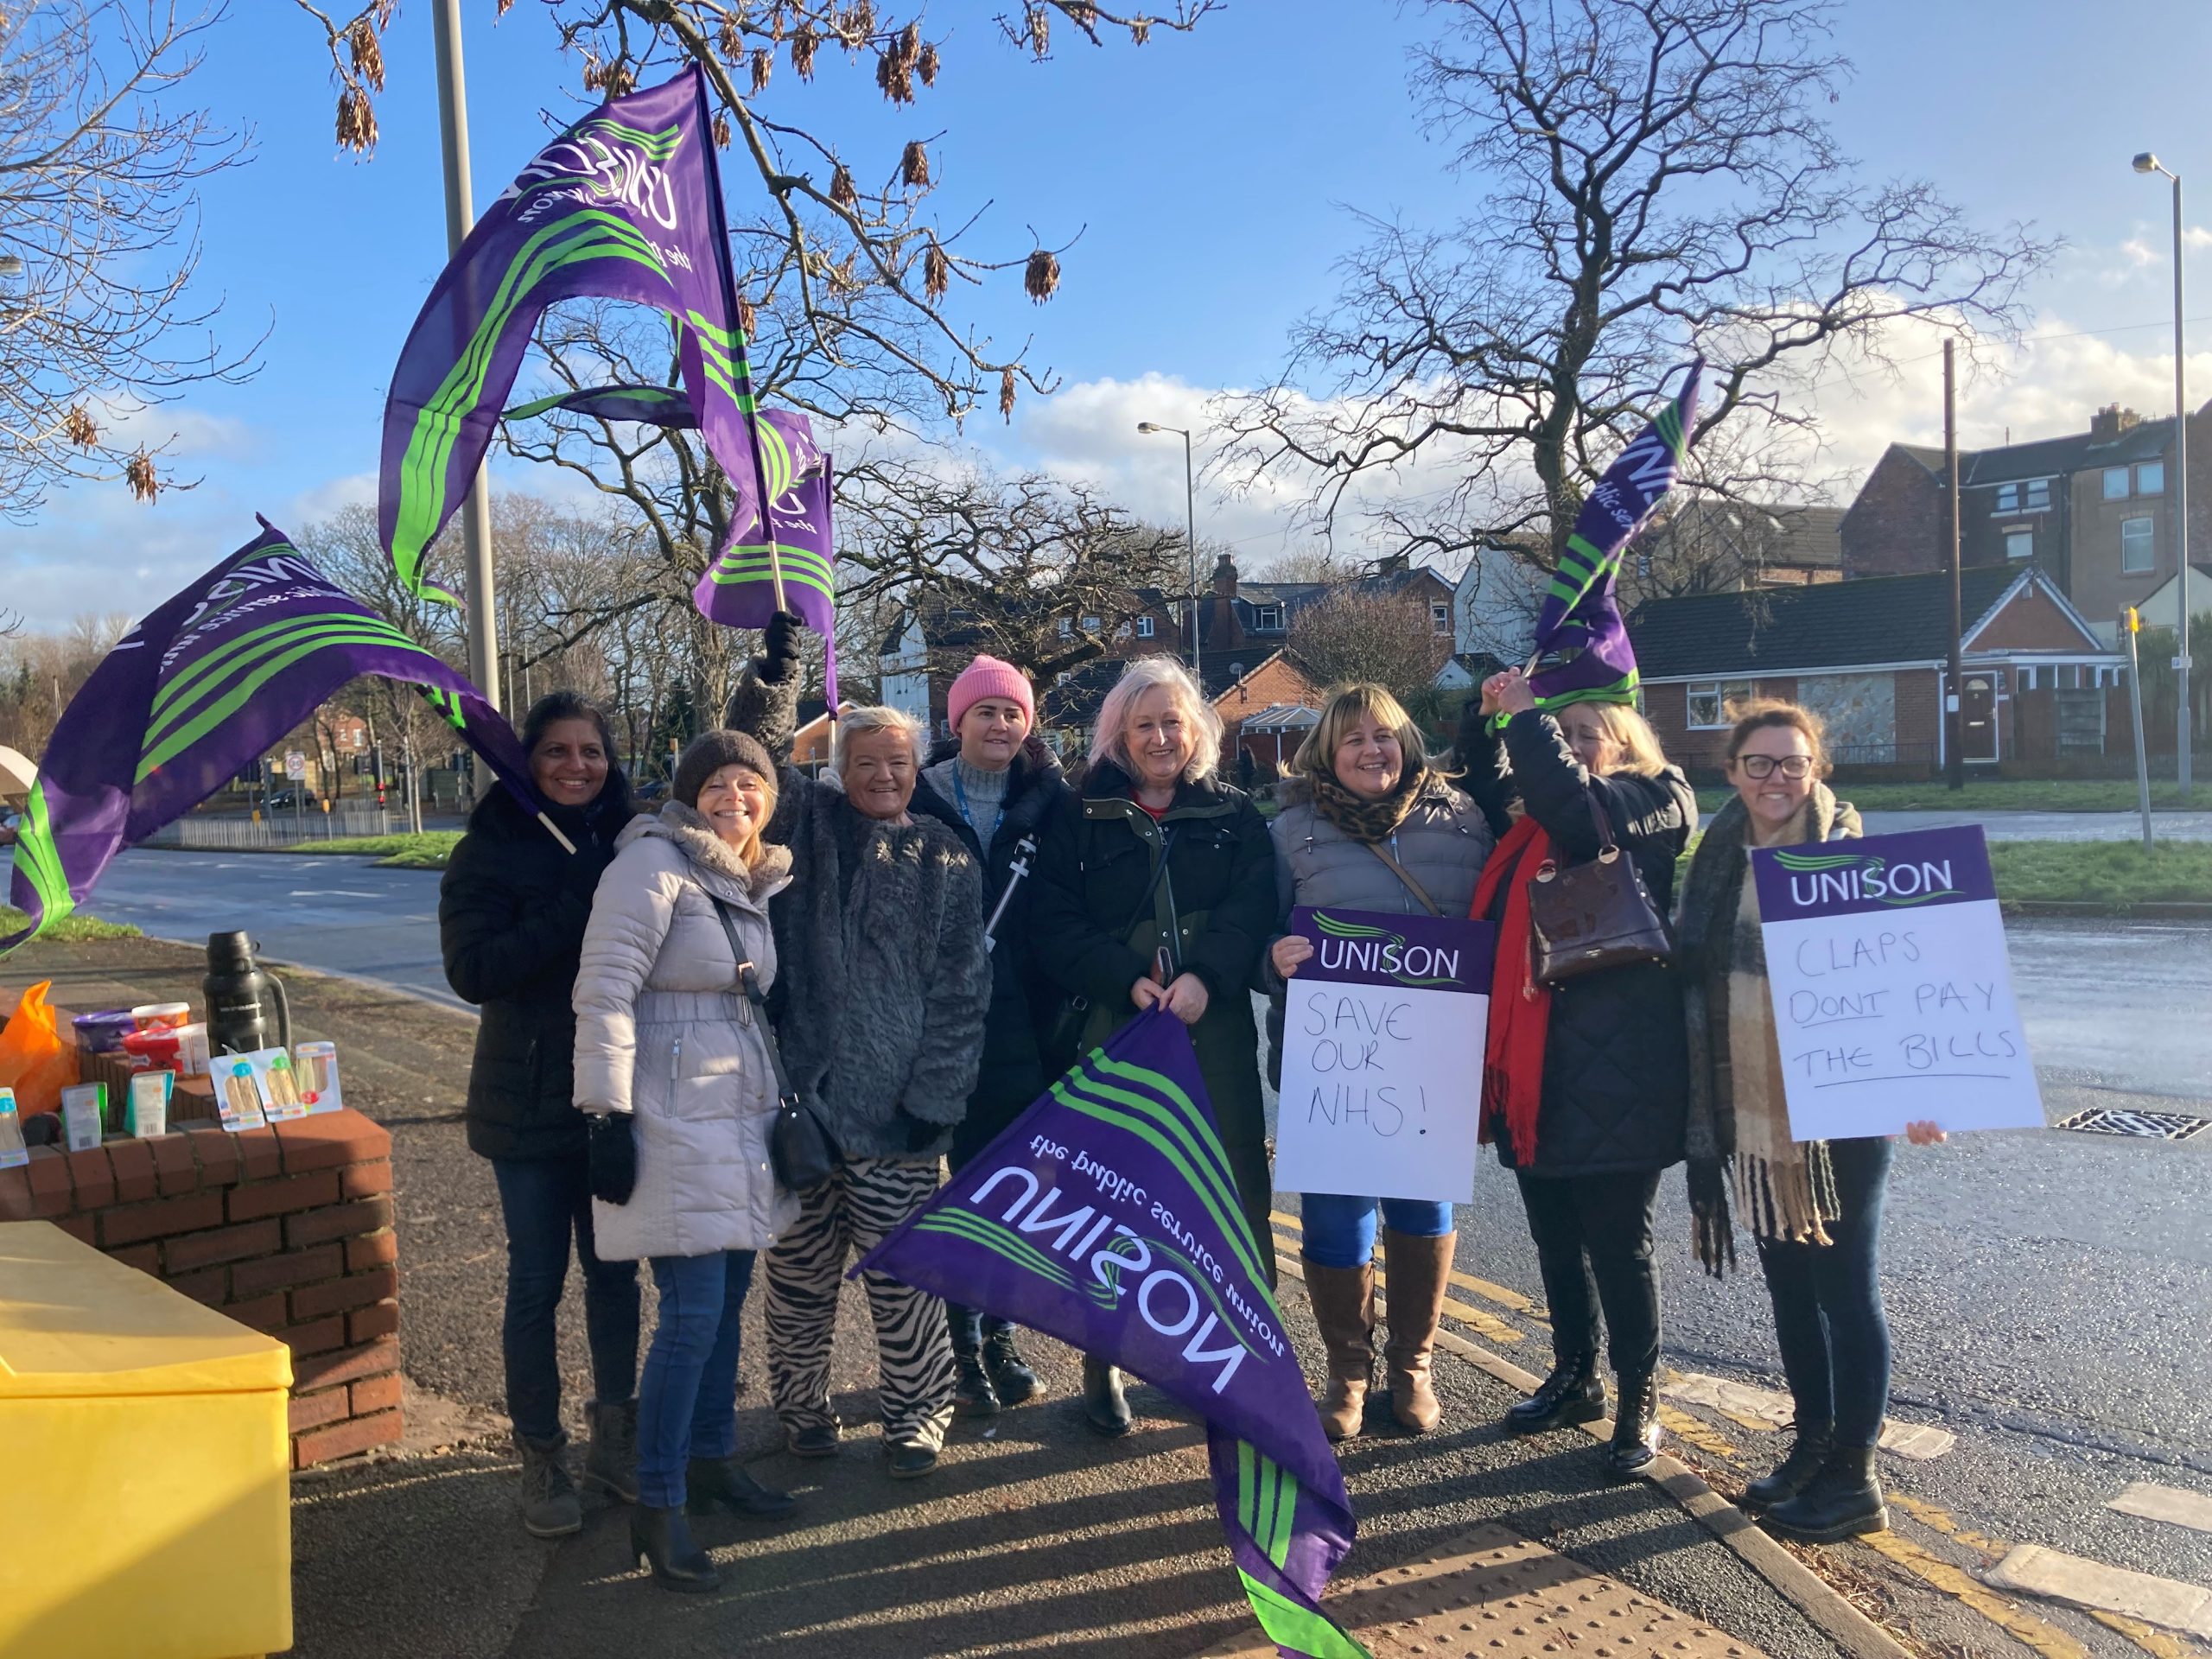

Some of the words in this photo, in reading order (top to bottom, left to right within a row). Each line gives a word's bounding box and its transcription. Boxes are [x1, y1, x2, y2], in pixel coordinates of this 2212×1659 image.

[1790, 860, 1954, 906] UNISON
[1319, 938, 1459, 979] UNISON
[1796, 931, 1921, 977] CLAPS
[1304, 992, 1412, 1041] SAVE
[1789, 989, 1891, 1024] DONT
[1914, 982, 1994, 1014] PAY
[1312, 1039, 1385, 1072] OUR
[1792, 1047, 1873, 1077] THE
[1898, 1030, 2017, 1070] BILLS
